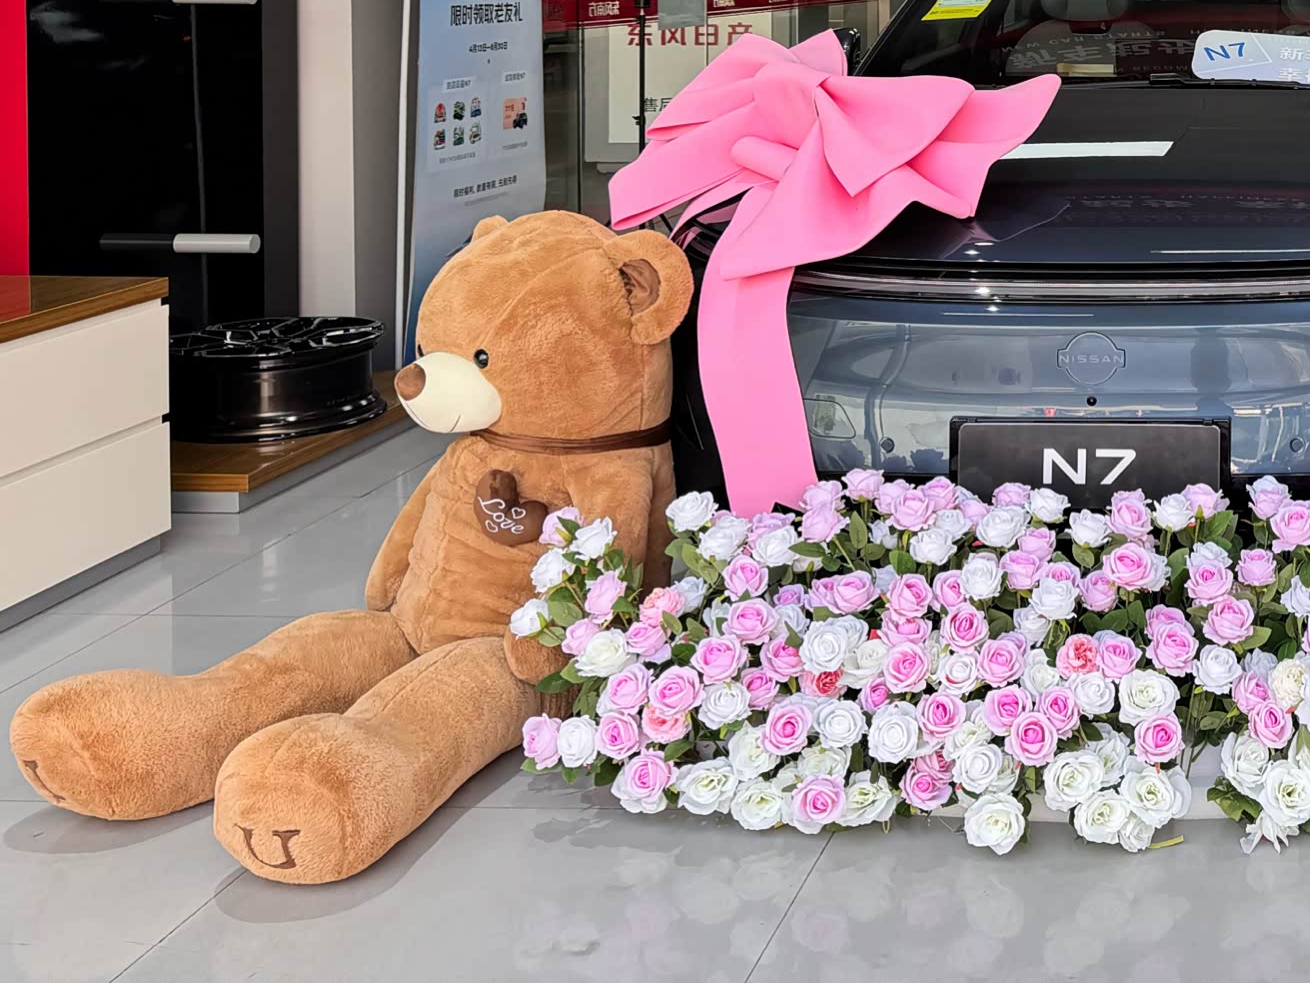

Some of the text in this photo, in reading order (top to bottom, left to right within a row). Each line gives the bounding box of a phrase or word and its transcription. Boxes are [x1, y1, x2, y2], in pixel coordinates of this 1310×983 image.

[450, 2, 523, 26] 限时领取老友礼
[1203, 42, 1246, 61] N7
[1059, 354, 1123, 364] NISSAN
[1042, 448, 1136, 485] N7
[477, 496, 525, 534] Love
